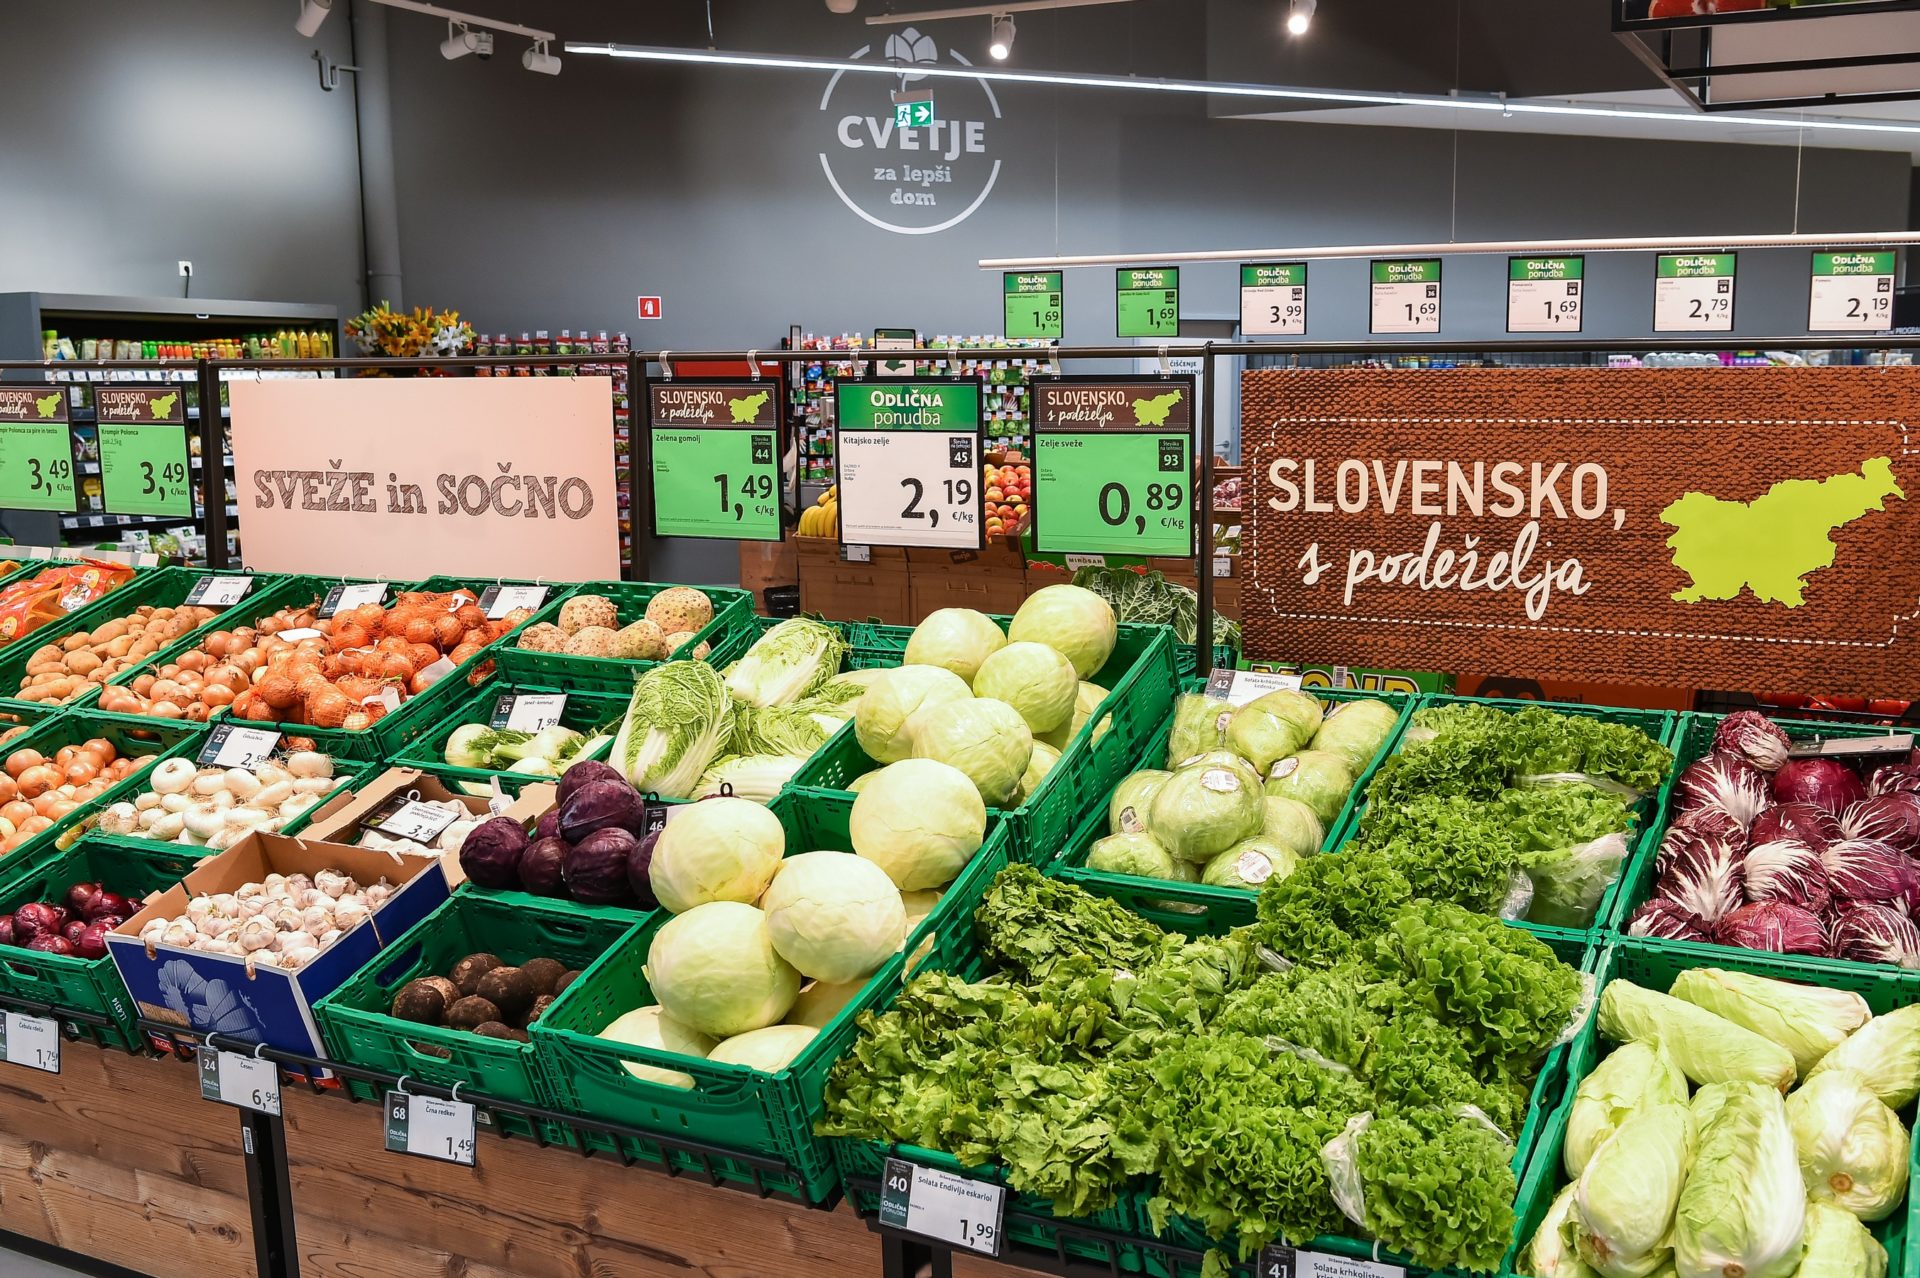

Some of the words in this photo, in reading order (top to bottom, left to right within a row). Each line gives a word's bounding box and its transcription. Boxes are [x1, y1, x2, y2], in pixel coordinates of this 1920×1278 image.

[837, 115, 986, 161] CVETJE
[874, 167, 896, 181] za
[903, 165, 952, 187] lepši
[890, 188, 936, 206] dom
[1527, 260, 1565, 270] ODLIČNA
[1675, 257, 1716, 267] ODLIČNA
[1831, 255, 1875, 264] ODLIČNA
[1132, 271, 1164, 280] ODLIČNA
[1256, 268, 1290, 277] ODLIČNA
[1388, 264, 1424, 274] ODLIČNA
[1528, 270, 1564, 280] ponudba
[1677, 266, 1715, 277] ponudba
[1832, 264, 1873, 275] ponudba
[1018, 276, 1048, 284] ODLIČNA
[1132, 279, 1162, 288] ponudba
[1258, 276, 1290, 286] ponudba
[1389, 273, 1422, 282] ponudba
[1018, 283, 1047, 292] ponudba
[1270, 306, 1302, 326] 3,99
[1404, 302, 1436, 325] 1,69
[1544, 300, 1578, 322] 1,69
[1689, 298, 1728, 322] 2,79
[1846, 297, 1888, 322] 2,19
[1033, 311, 1058, 330] 1,69
[1147, 308, 1174, 329] 1,69
[0, 392, 35, 405] OVENSKO,
[102, 392, 148, 406] SLOVENSKO,
[660, 390, 726, 406] SLOVENSKO,
[870, 388, 944, 408] ODLIČNA
[1047, 390, 1130, 408] SLOVENSKO,
[0, 401, 28, 419] odeželja
[108, 401, 141, 420] podeželja
[660, 406, 667, 418] s
[670, 402, 714, 424] podeželja
[1047, 408, 1056, 422] s
[1058, 402, 1115, 428] podeželja
[874, 408, 941, 430] ponudba
[678, 434, 700, 444] gomolj
[844, 436, 872, 446] Kitajsko
[873, 437, 890, 446] zelje
[1040, 440, 1060, 449] Zelje
[1061, 440, 1084, 448] sveže
[755, 448, 769, 460] 44
[954, 452, 968, 463] 45
[1164, 454, 1179, 466] 93
[28, 458, 70, 496] 3,49
[140, 461, 184, 502] 3,49
[253, 458, 377, 514] SVEŽE
[387, 473, 427, 515] in
[437, 461, 595, 521] SOČNO
[1267, 457, 1627, 532] SLOVENSKO,
[714, 473, 773, 521] 1,49
[900, 478, 972, 528] 2,19
[755, 505, 774, 516] €/kg
[1098, 482, 1183, 536] 0,89
[952, 511, 974, 523] €/kg
[1160, 517, 1184, 530] €/kg
[1297, 541, 1332, 586] s
[1343, 521, 1592, 621] podeželja
[1214, 680, 1228, 689] 42
[500, 704, 510, 714] 55
[214, 734, 226, 743] 22
[650, 820, 664, 832] 46
[204, 1058, 216, 1072] 24
[392, 1106, 406, 1120] 68
[426, 1106, 438, 1114] Črna
[438, 1108, 456, 1117] redkev
[446, 1136, 472, 1160] 1,49
[888, 1176, 908, 1192] 40
[918, 1176, 939, 1188] Solata
[939, 1182, 965, 1196] Endivija
[966, 1190, 992, 1202] eskariol
[883, 1200, 907, 1212] ODLIČNA
[960, 1219, 994, 1246] 1,99
[1268, 1263, 1288, 1278] 41
[1314, 1262, 1338, 1274] Solata
